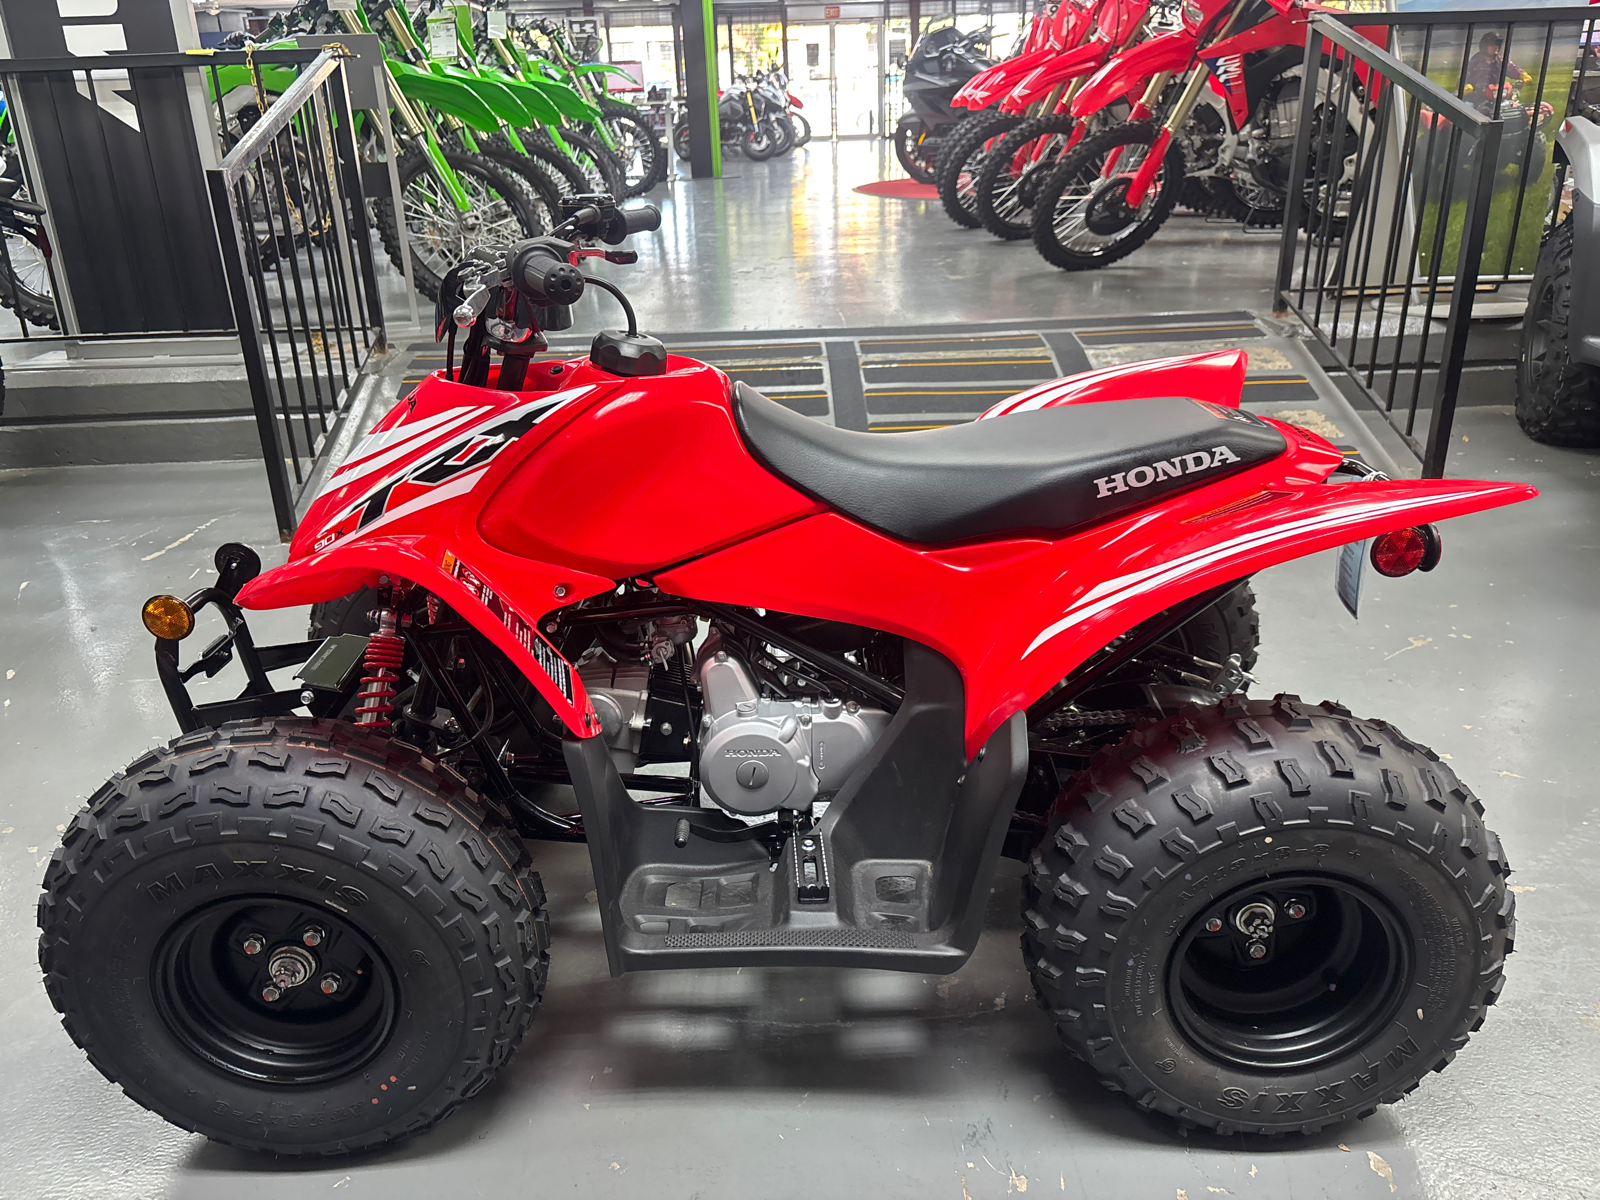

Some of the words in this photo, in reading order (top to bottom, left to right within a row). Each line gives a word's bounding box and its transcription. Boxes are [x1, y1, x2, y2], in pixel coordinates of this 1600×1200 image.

[343, 398, 568, 535] TRX
[1093, 445, 1241, 499] HONDA
[724, 748, 782, 758] HONDA
[146, 859, 370, 908] MAXXIS
[1216, 1035, 1420, 1113] MAXXIS
